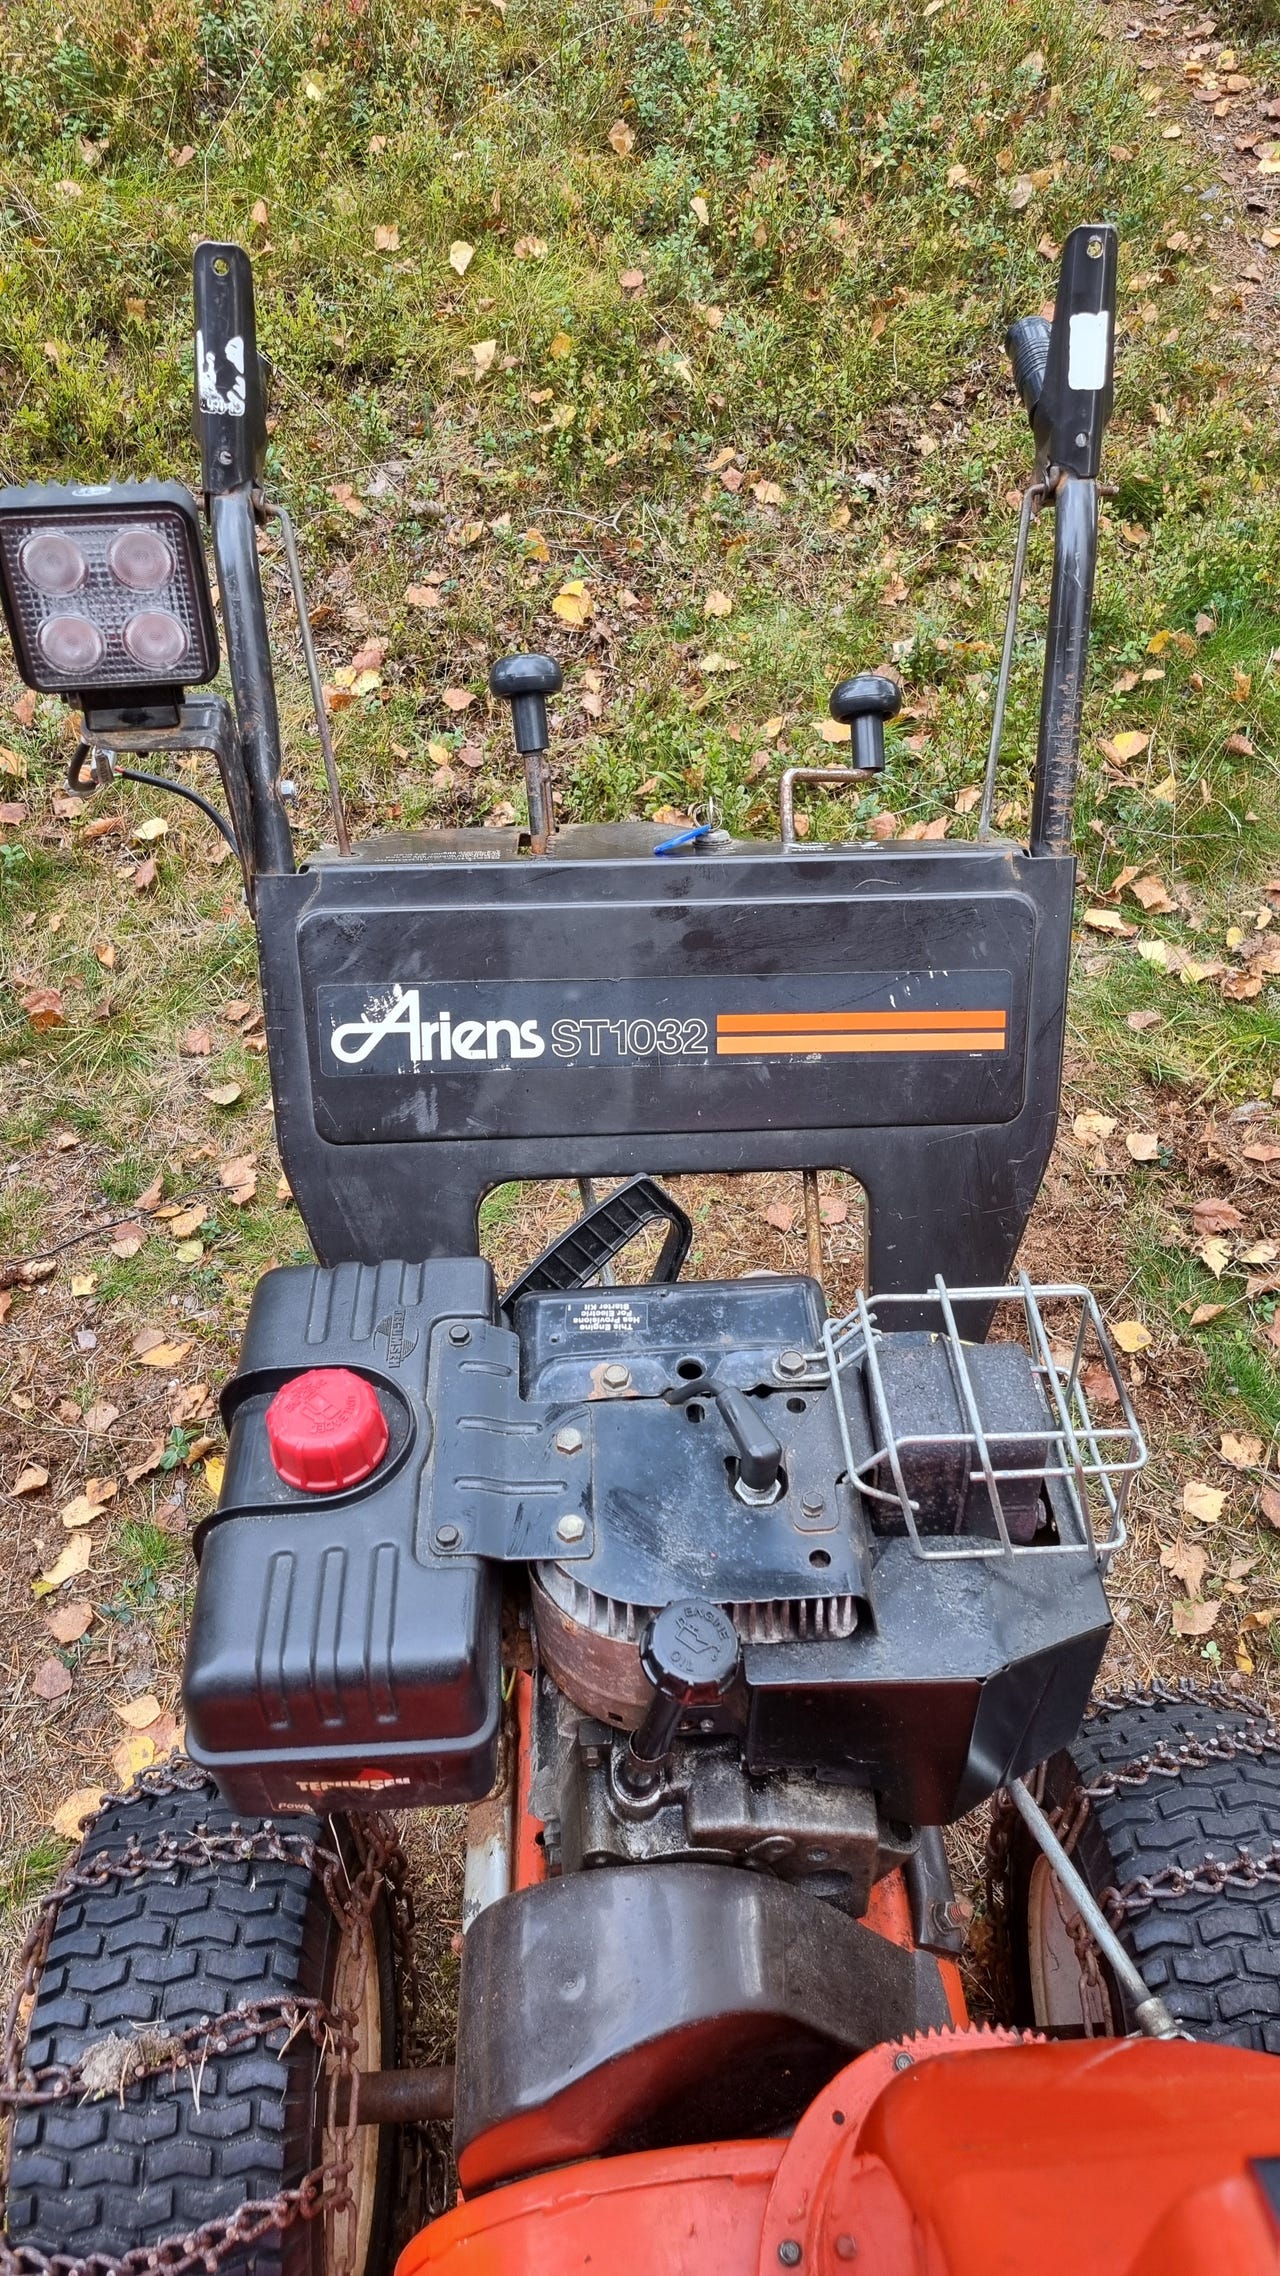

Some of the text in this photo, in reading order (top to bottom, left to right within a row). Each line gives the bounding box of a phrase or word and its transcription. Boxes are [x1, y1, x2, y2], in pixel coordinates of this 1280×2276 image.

[331, 989, 708, 1063] Ariens ST1032
[572, 1316, 640, 1324] Has Provisions
[579, 1323, 633, 1331] This Engine
[684, 1607, 729, 1641] ENGINE
[671, 1651, 694, 1673] OIL
[278, 1802, 313, 1812] Powe
